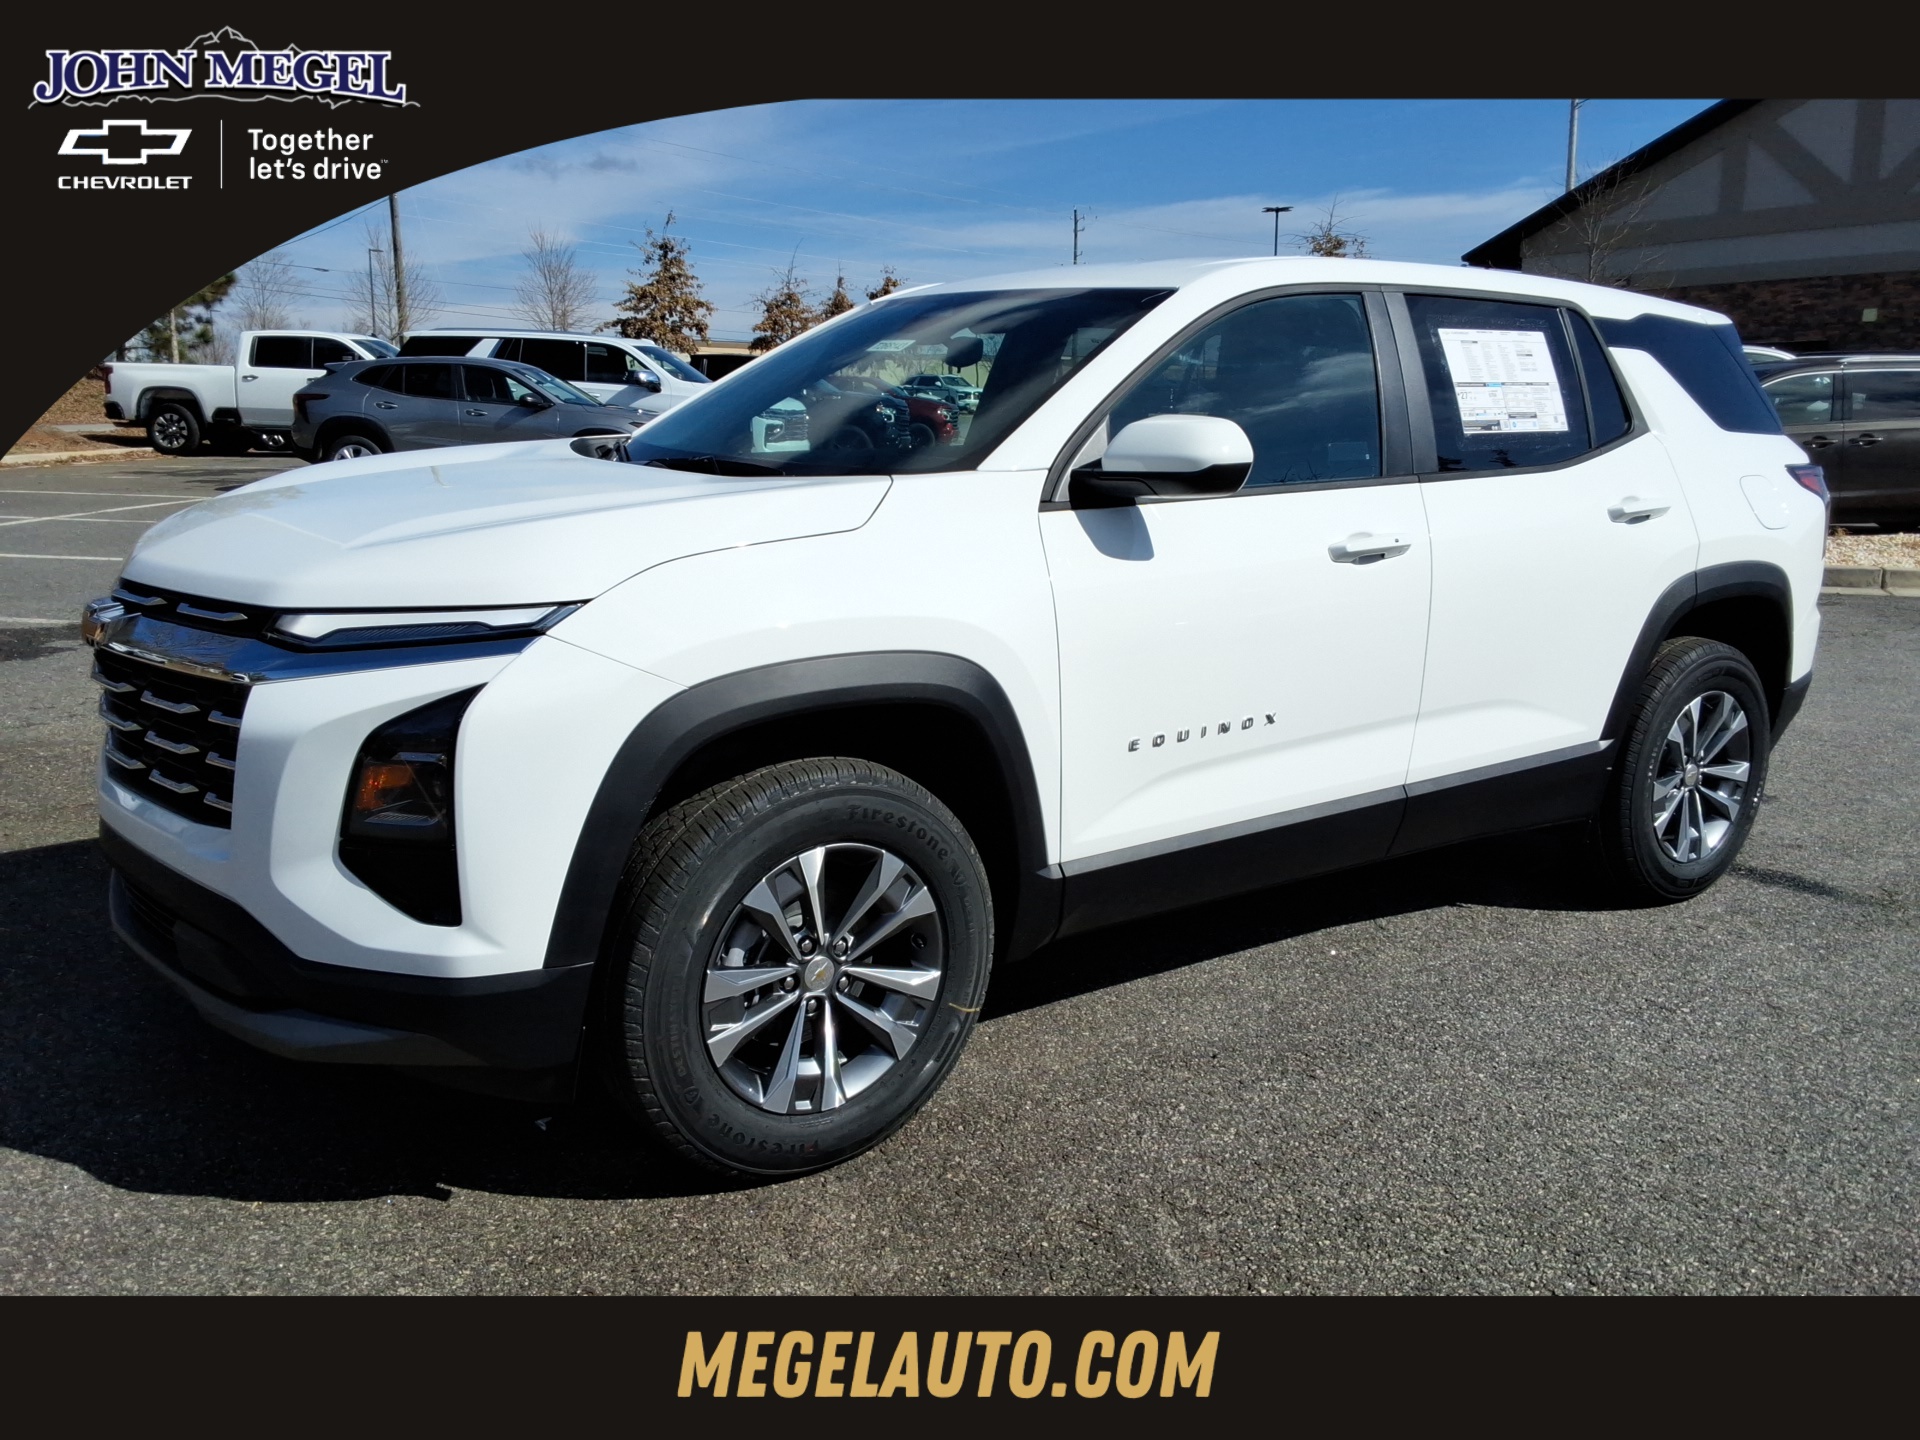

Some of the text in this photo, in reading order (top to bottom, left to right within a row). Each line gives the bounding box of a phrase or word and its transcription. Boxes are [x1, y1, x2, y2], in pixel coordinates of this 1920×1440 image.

[1128, 712, 1276, 752] EQUINOX
[847, 804, 950, 859] Firestone
[707, 1113, 820, 1158] Firestone
